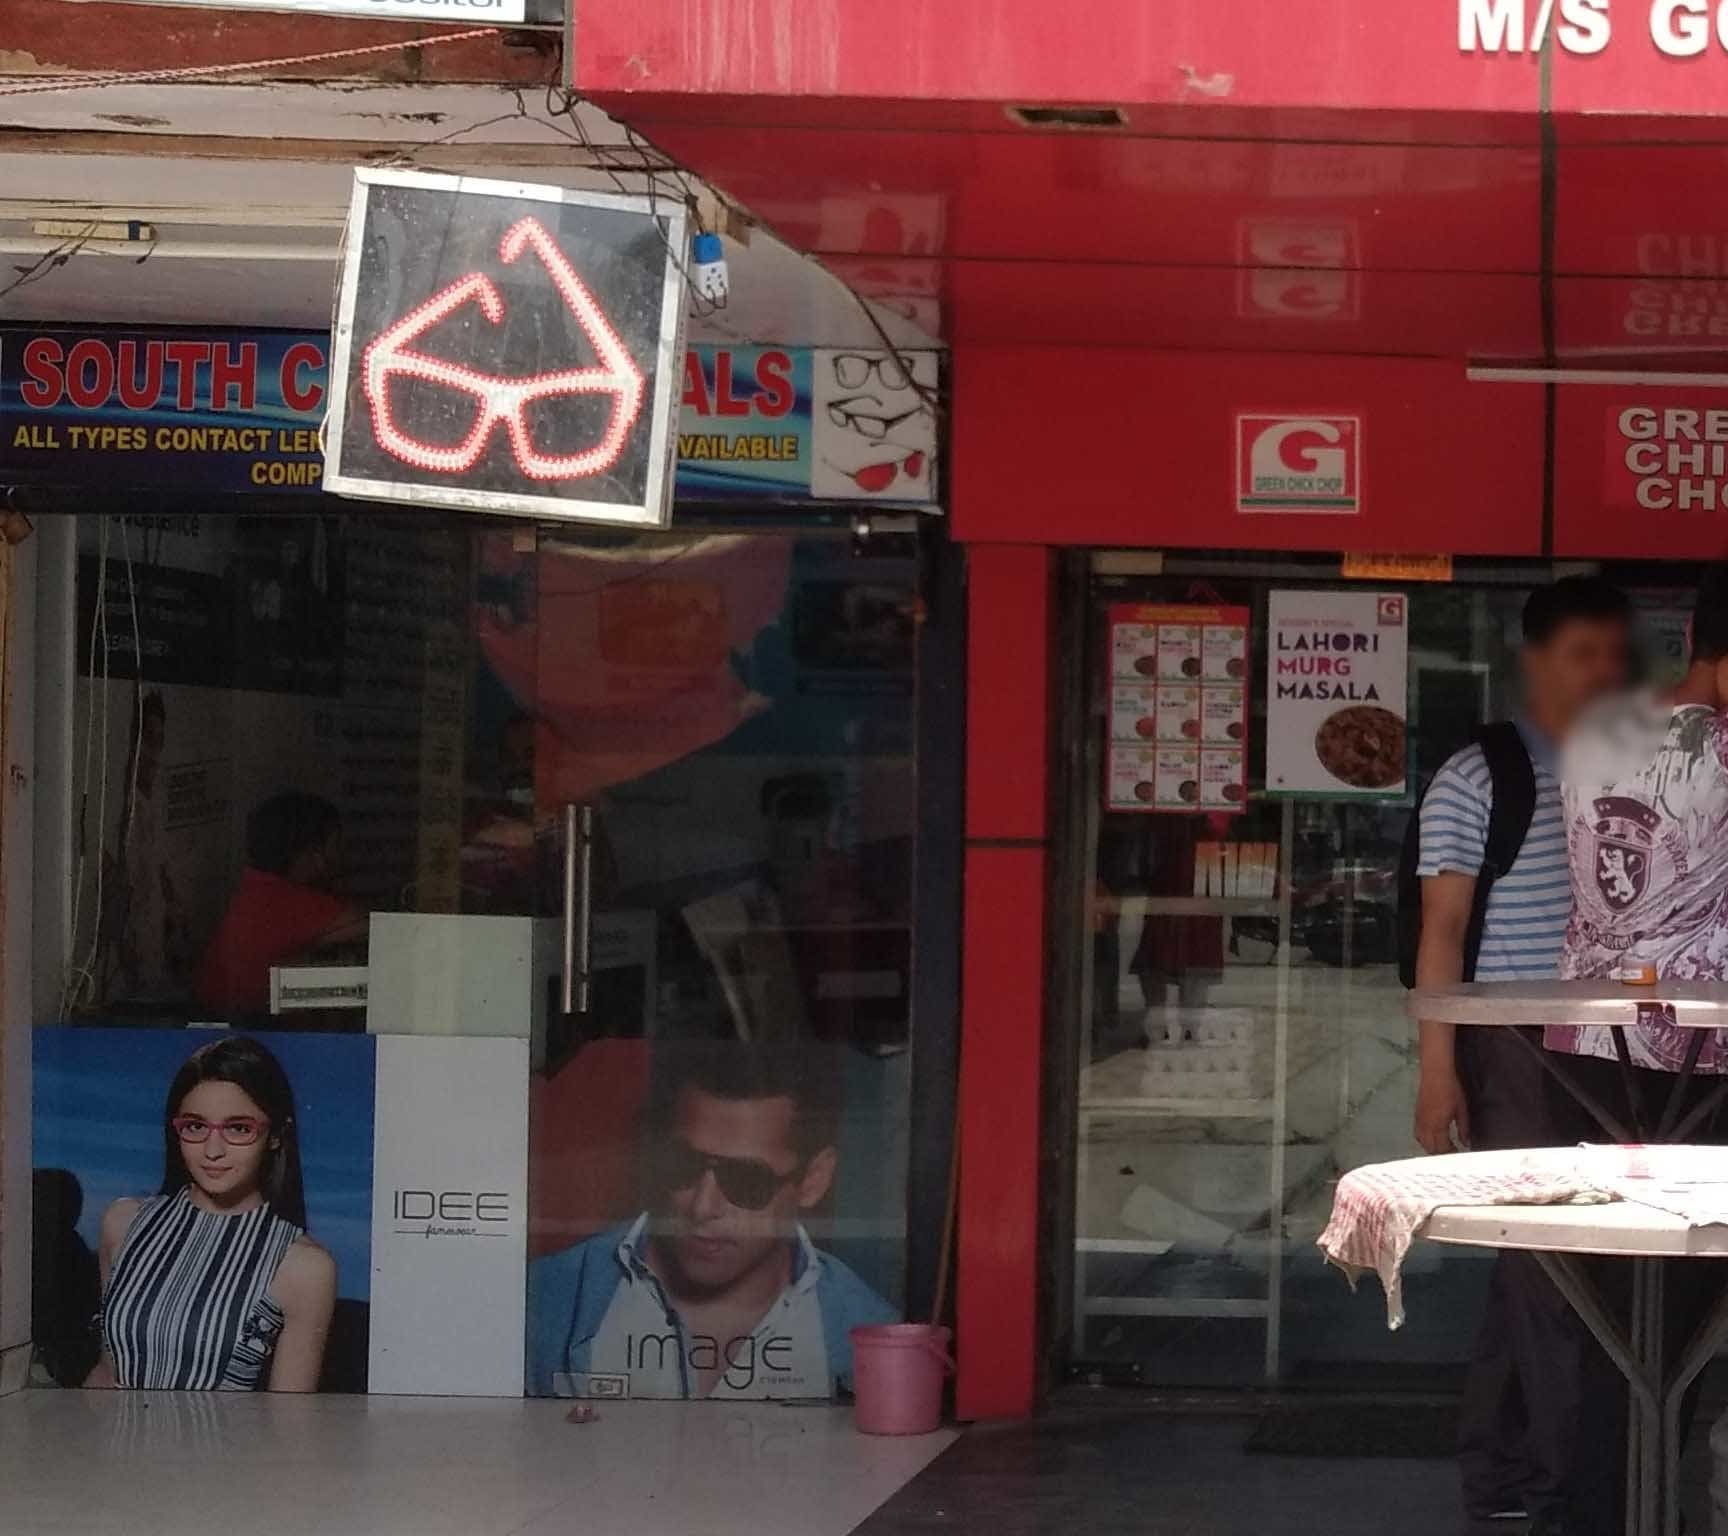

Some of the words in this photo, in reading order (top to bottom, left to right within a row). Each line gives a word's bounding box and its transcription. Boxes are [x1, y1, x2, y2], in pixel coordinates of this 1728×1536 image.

[20, 337, 258, 412] SOUTH
[280, 342, 326, 412] C
[681, 350, 795, 417] ALS
[14, 425, 60, 449] ALL
[68, 426, 148, 451] TYPES
[155, 428, 272, 453] CONTACT
[279, 430, 324, 454] LEN
[677, 433, 799, 461] VAILABLE
[251, 462, 322, 486] COMP
[1277, 632, 1380, 653] LAHORI
[1277, 657, 1351, 676] MURG
[1277, 681, 1380, 701] MASALA
[393, 1190, 509, 1222] IDEE
